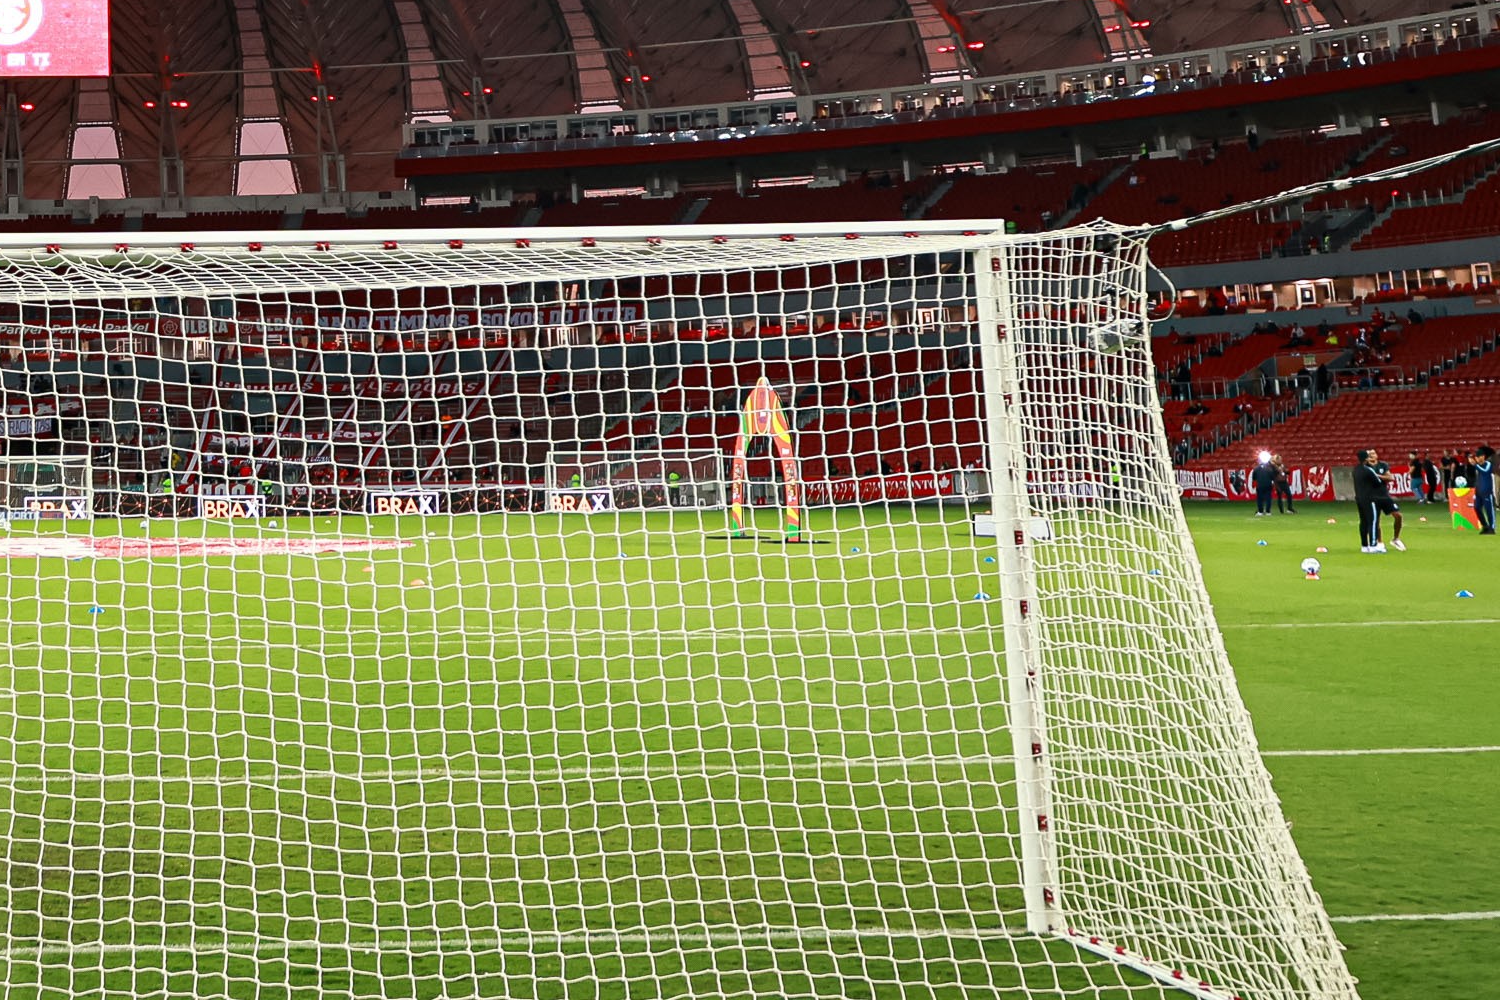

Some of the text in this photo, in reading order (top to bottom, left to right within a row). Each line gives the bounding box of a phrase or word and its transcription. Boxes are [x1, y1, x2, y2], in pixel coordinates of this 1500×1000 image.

[318, 316, 369, 330] NADA
[1175, 469, 1194, 487] LORES
[204, 500, 259, 519] BRAX
[377, 495, 433, 514] BRAX
[551, 494, 606, 513] BRAX
